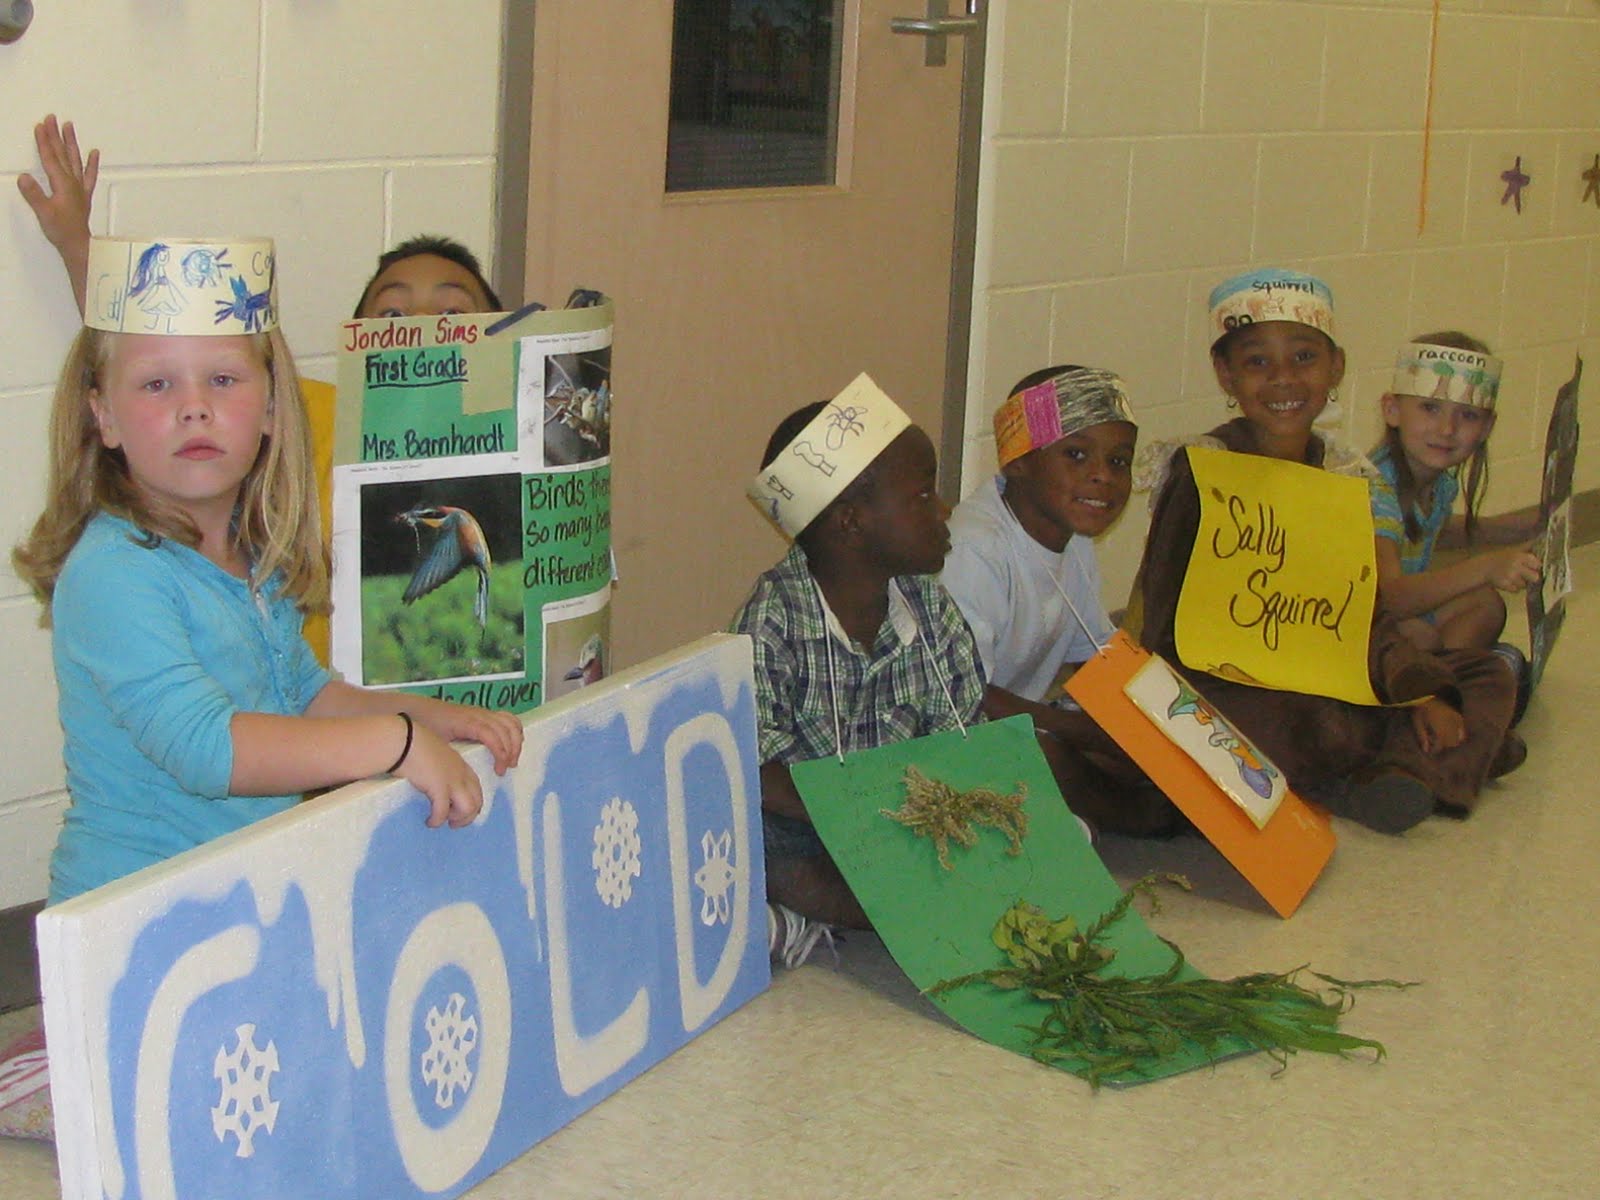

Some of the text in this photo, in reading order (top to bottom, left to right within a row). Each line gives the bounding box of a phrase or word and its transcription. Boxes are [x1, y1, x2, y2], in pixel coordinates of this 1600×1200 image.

[1252, 279, 1314, 295] squirrel
[344, 317, 478, 352] Jordan Sims
[365, 350, 468, 383] First Grade
[1418, 349, 1487, 368] raccoon
[363, 423, 504, 460] Mrs. Barnhardt
[525, 475, 588, 511] Birds,
[526, 520, 550, 547] So
[554, 514, 592, 547] many
[1213, 495, 1285, 573] Sally
[523, 553, 594, 589] different
[1229, 569, 1354, 651] Squirrel
[460, 682, 494, 709] all
[496, 681, 541, 708] over
[135, 712, 750, 1200] COLD
